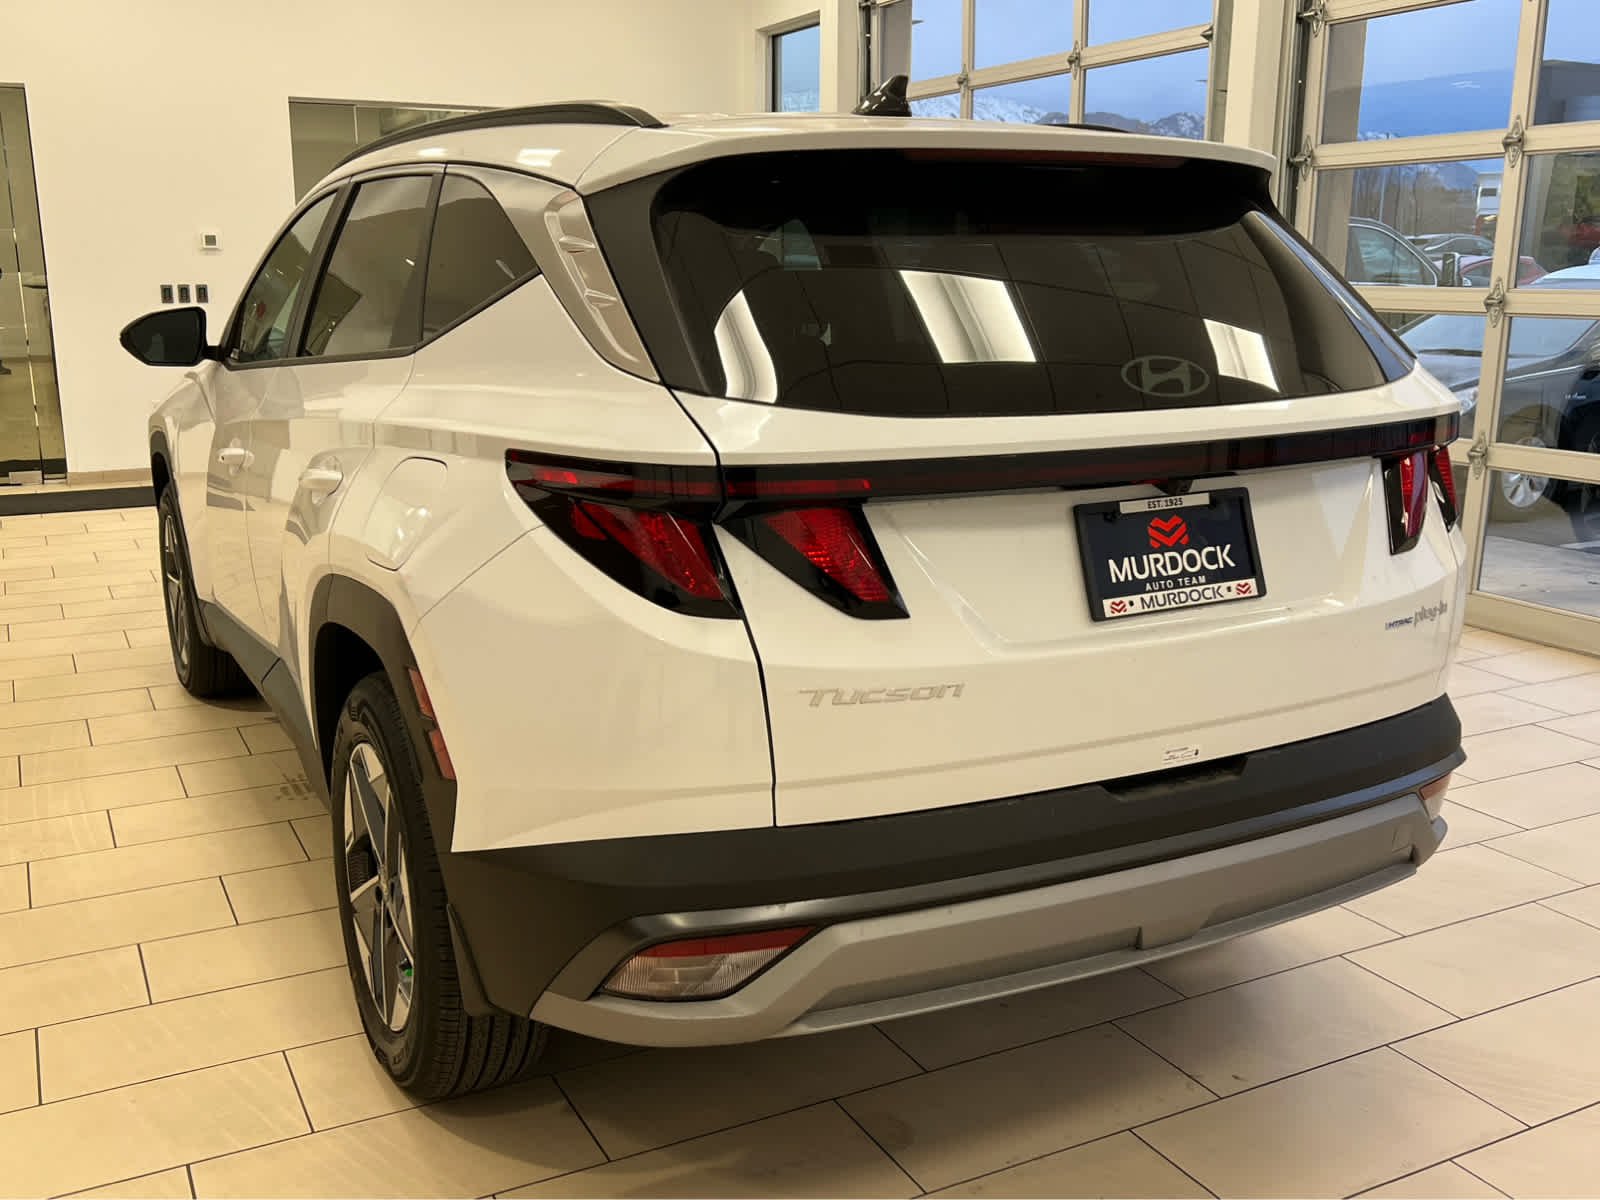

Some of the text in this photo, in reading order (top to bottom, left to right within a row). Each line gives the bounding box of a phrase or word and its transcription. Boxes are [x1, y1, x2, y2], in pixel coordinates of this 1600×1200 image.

[1147, 497, 1183, 509] EST. 1925
[1108, 544, 1236, 583] MURDOCK
[1145, 575, 1206, 591] AUTO TEAM
[1140, 585, 1224, 610] MURDOCK
